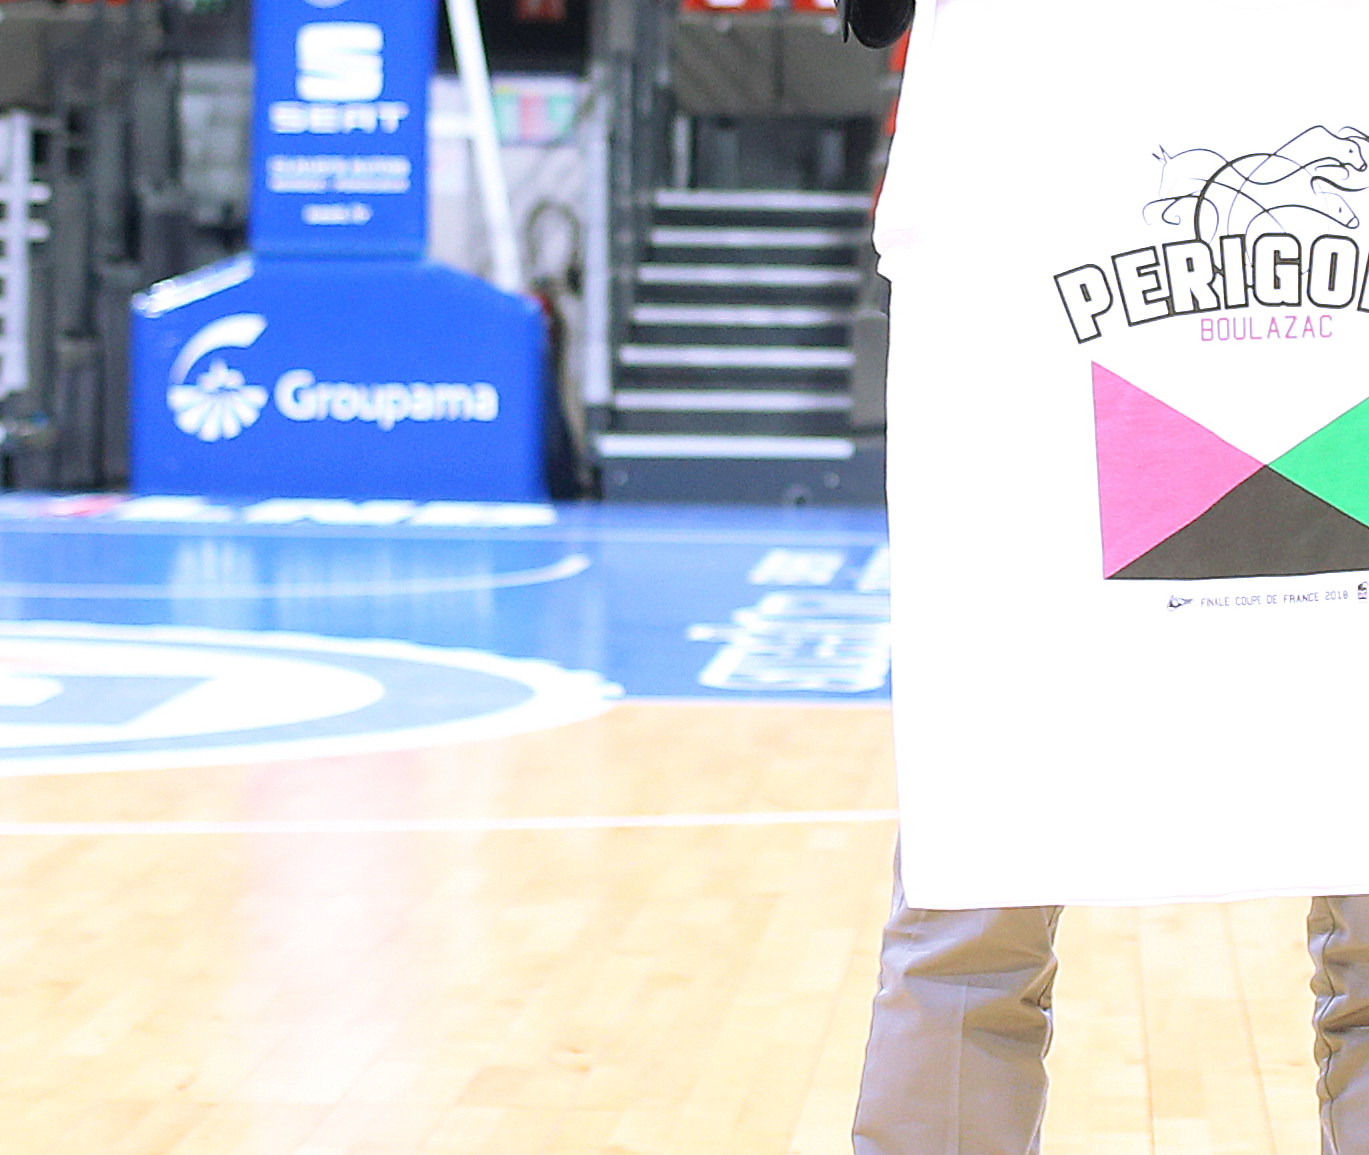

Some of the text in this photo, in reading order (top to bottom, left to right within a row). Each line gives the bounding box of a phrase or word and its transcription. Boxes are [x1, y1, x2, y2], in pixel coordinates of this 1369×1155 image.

[268, 100, 410, 134] SEAT
[1200, 314, 1333, 342] BOULAZAC
[273, 368, 500, 432] Groupama
[1200, 596, 1230, 607] FINALE
[1235, 595, 1262, 606] COUPE
[1266, 594, 1278, 604] DE
[1283, 592, 1320, 604] FRANCE
